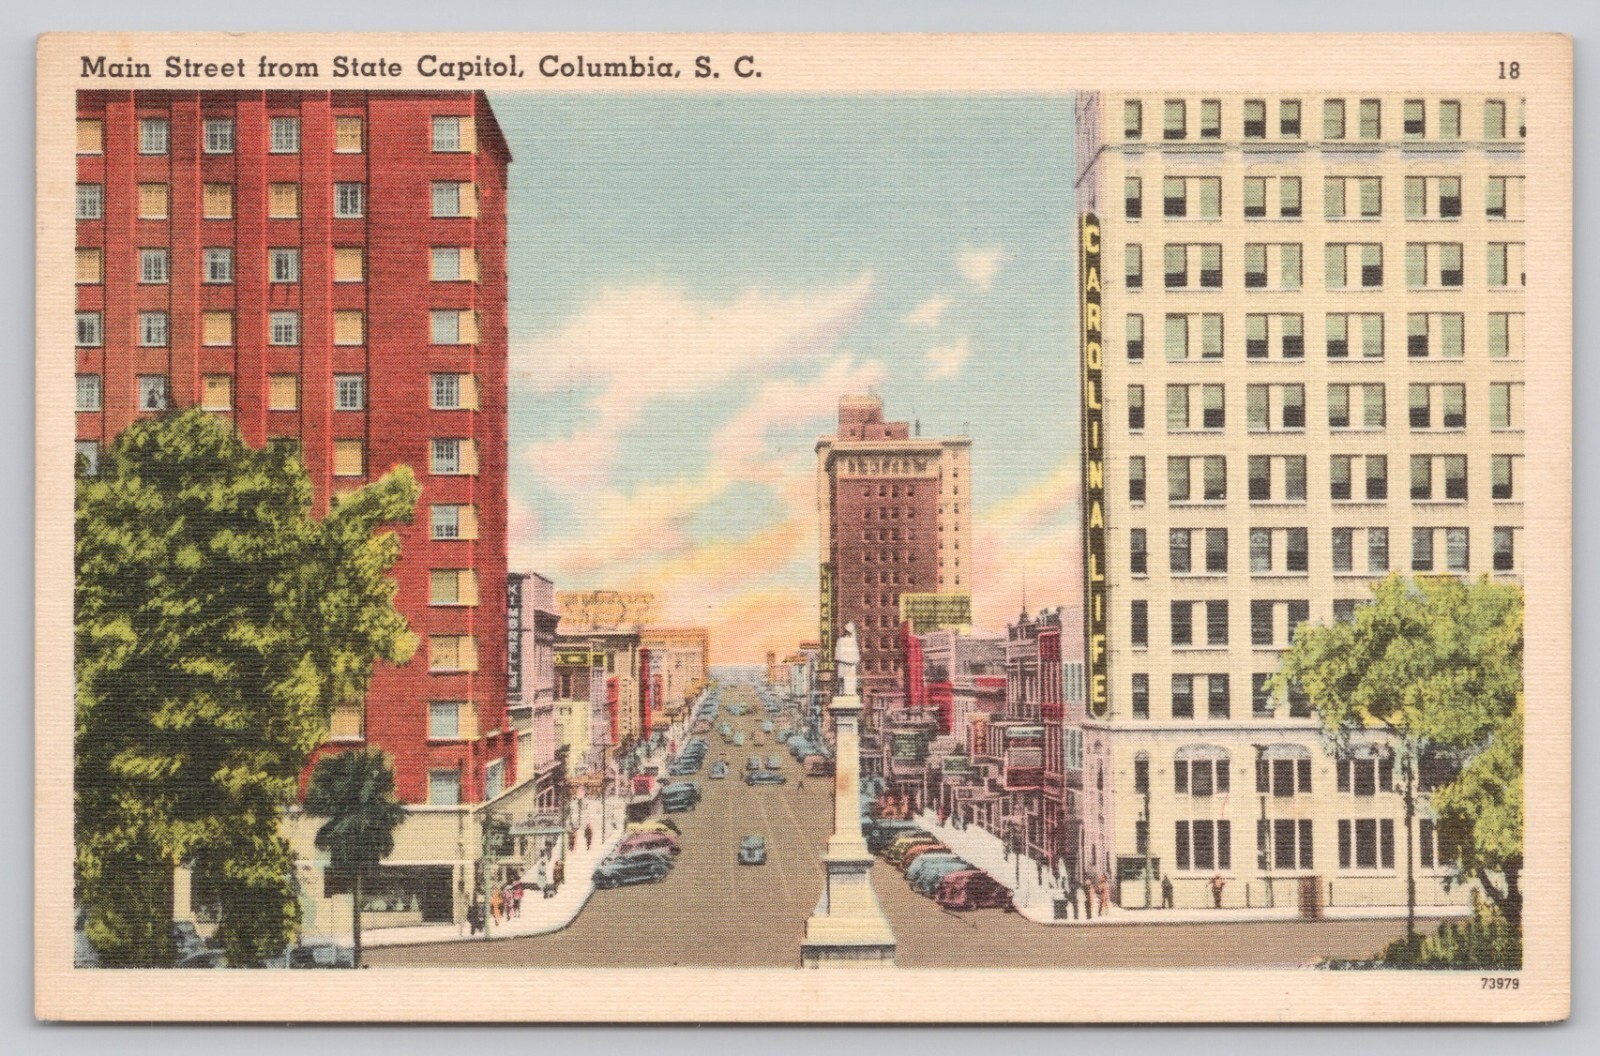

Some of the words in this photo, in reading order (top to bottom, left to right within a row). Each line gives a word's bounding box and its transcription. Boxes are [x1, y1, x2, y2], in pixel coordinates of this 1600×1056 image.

[80, 55, 152, 78] Main
[165, 55, 246, 78] Street
[258, 55, 320, 78] from
[332, 55, 403, 78] State
[416, 54, 524, 81] Capitol,
[538, 54, 681, 80] Columbia,
[694, 55, 720, 79] S.
[734, 55, 762, 79] C.
[1498, 61, 1520, 80] 18
[1084, 225, 1104, 528] CAROLINA
[1091, 553, 1107, 703] LIFE
[1481, 977, 1520, 990] 73979
